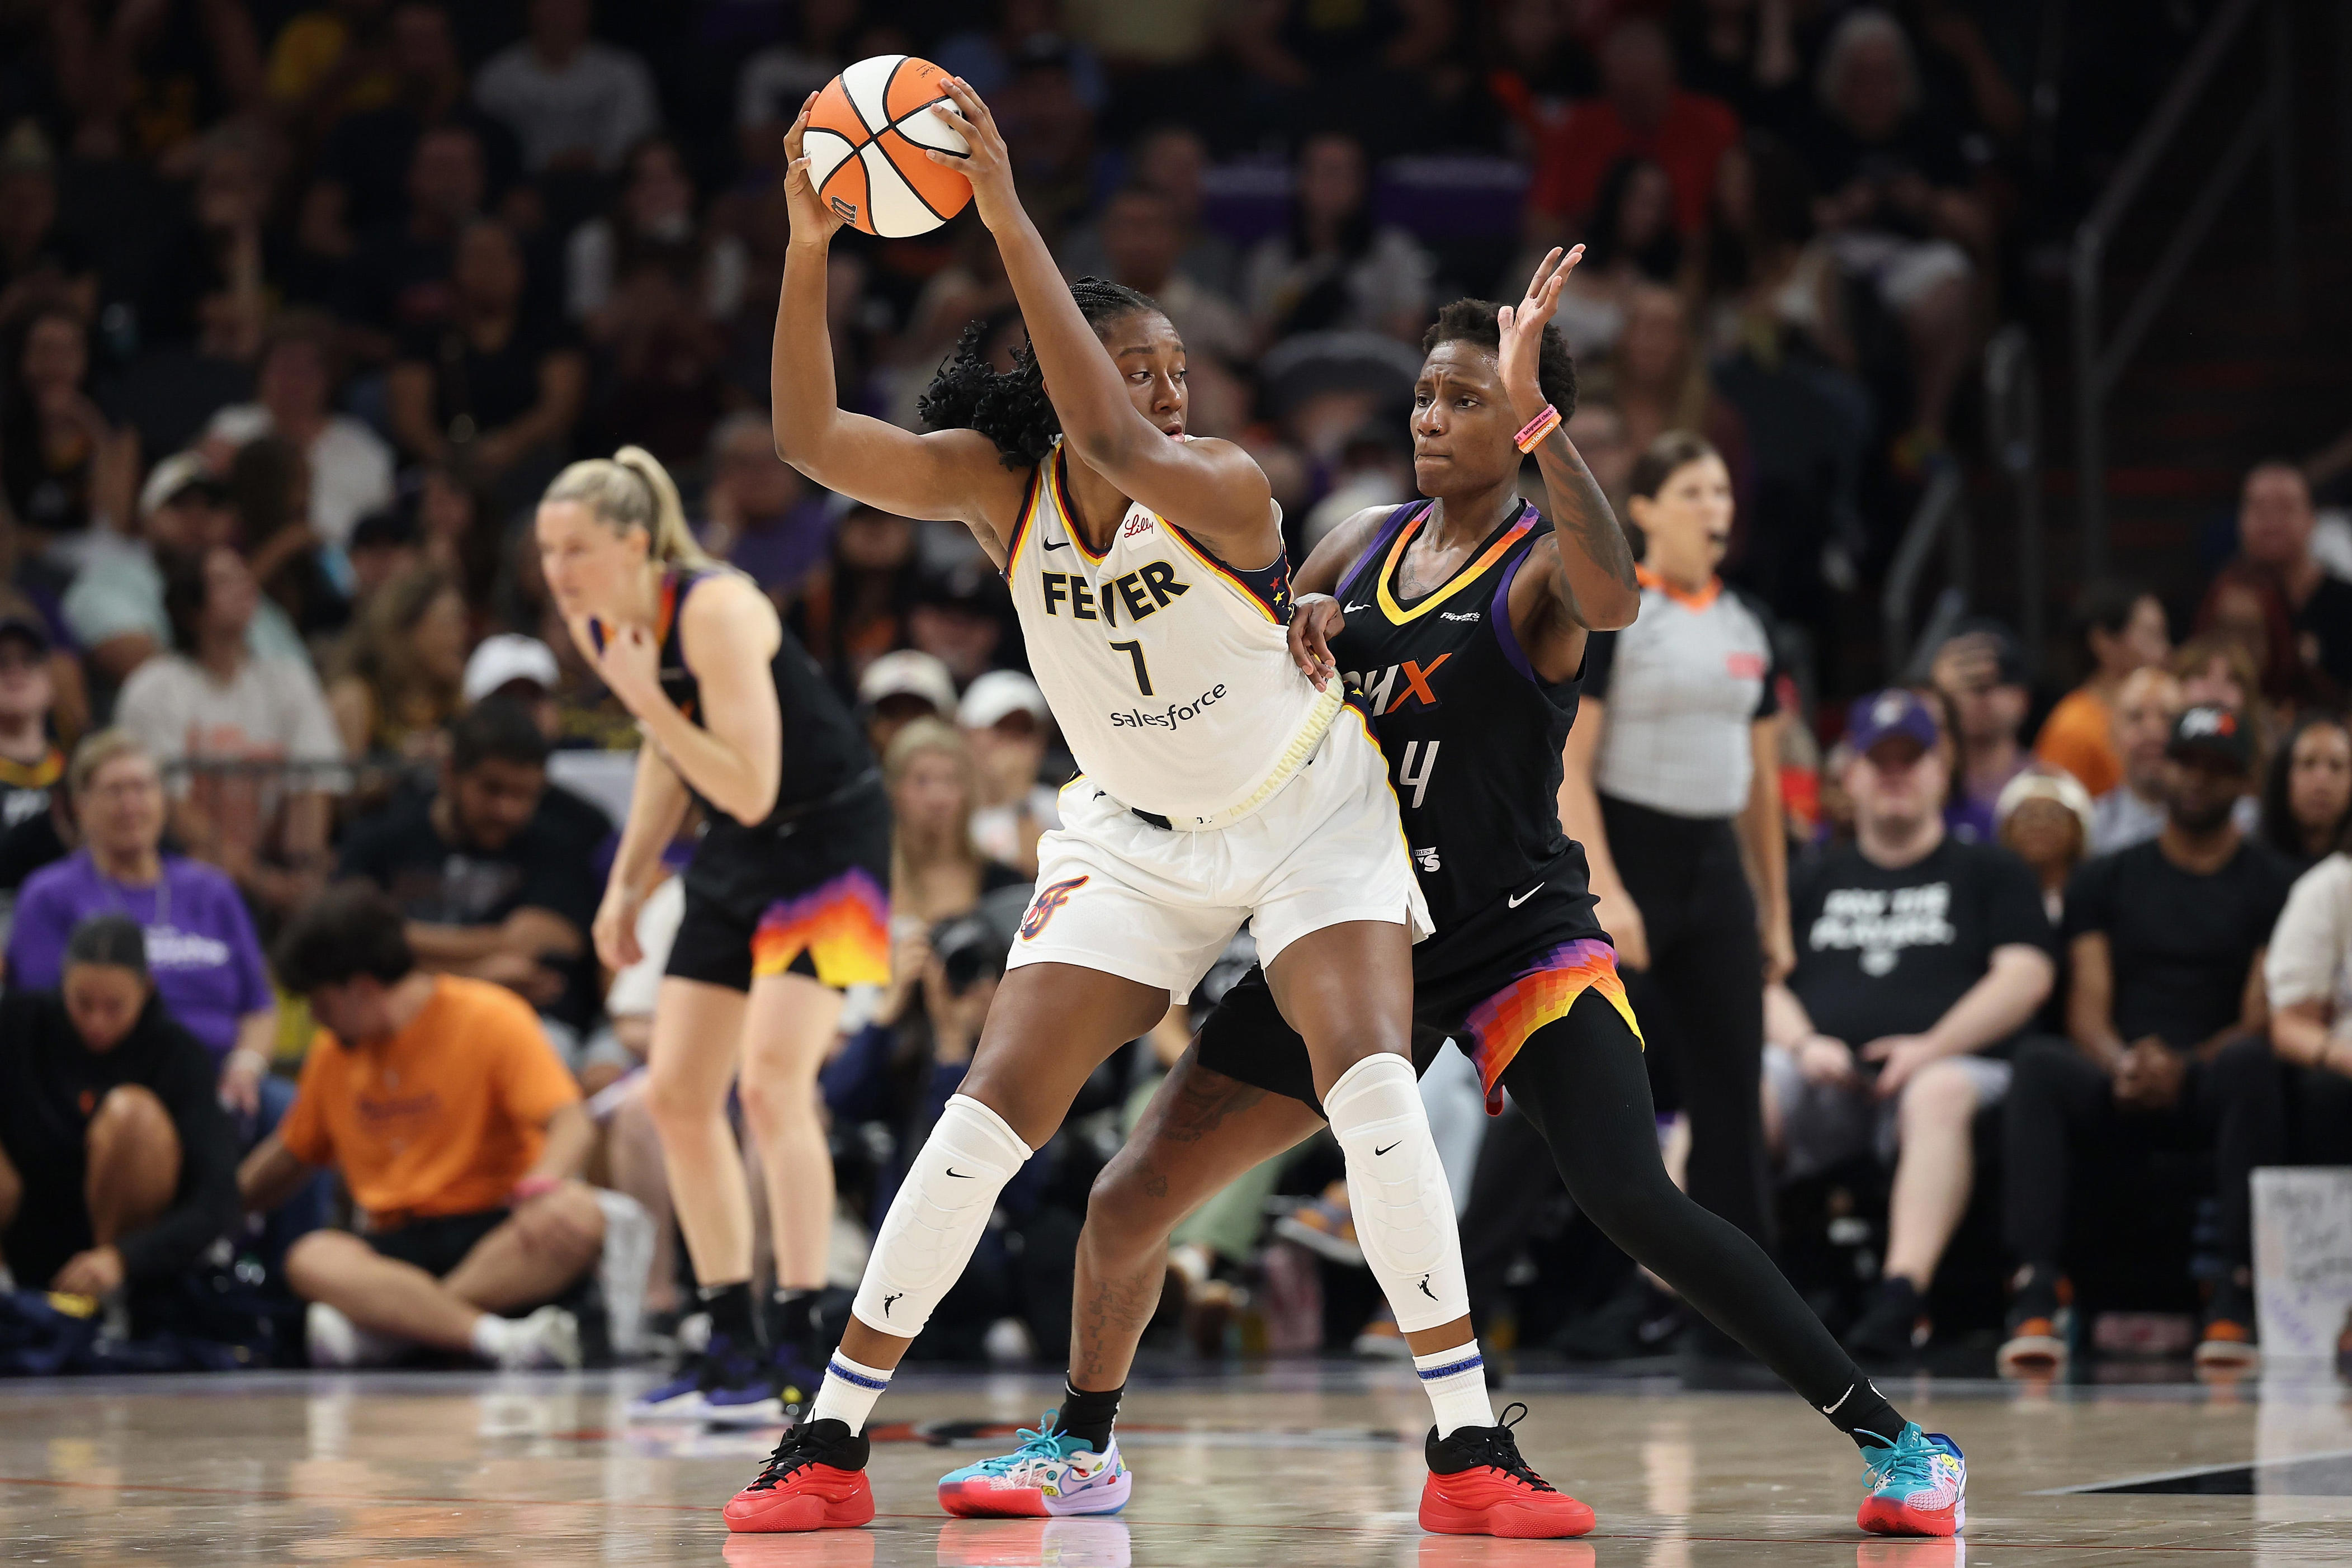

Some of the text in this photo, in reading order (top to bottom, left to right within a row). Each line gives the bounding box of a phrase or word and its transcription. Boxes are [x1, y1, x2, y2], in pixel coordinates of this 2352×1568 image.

[1124, 514, 1154, 538] Lilly
[1041, 559, 1193, 629] FEVER
[1109, 639, 1155, 697] 7
[1110, 683, 1227, 731] salesforce
[1399, 740, 1441, 809] 4
